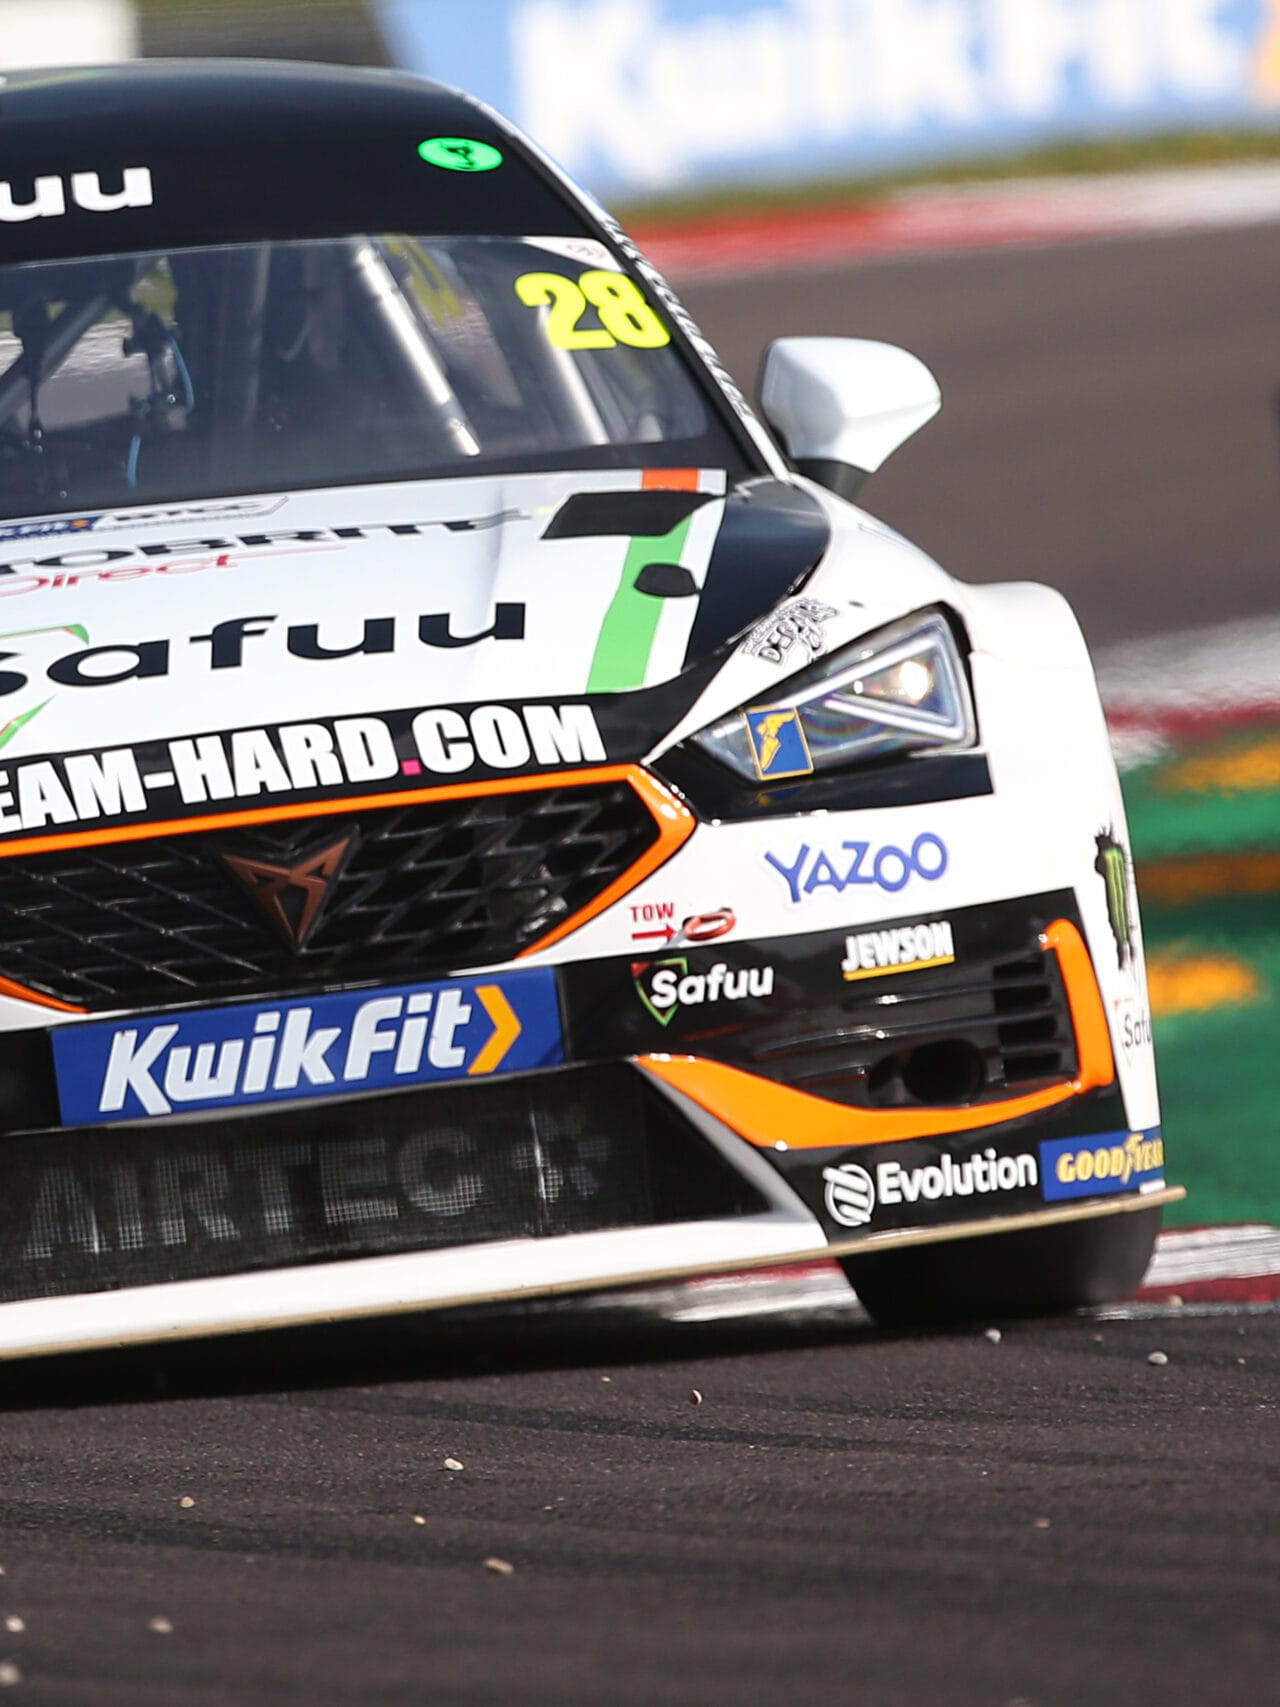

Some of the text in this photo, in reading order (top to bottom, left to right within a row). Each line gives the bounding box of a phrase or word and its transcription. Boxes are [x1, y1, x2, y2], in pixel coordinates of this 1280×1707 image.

[513, 269, 671, 350] 28
[764, 832, 949, 904] YAZOO
[629, 902, 675, 923] TOW
[840, 920, 954, 972] JEWSON
[649, 963, 775, 1008] Safuu
[23, 1125, 486, 1260] AIRTEC
[876, 1148, 1039, 1206] Evolution
